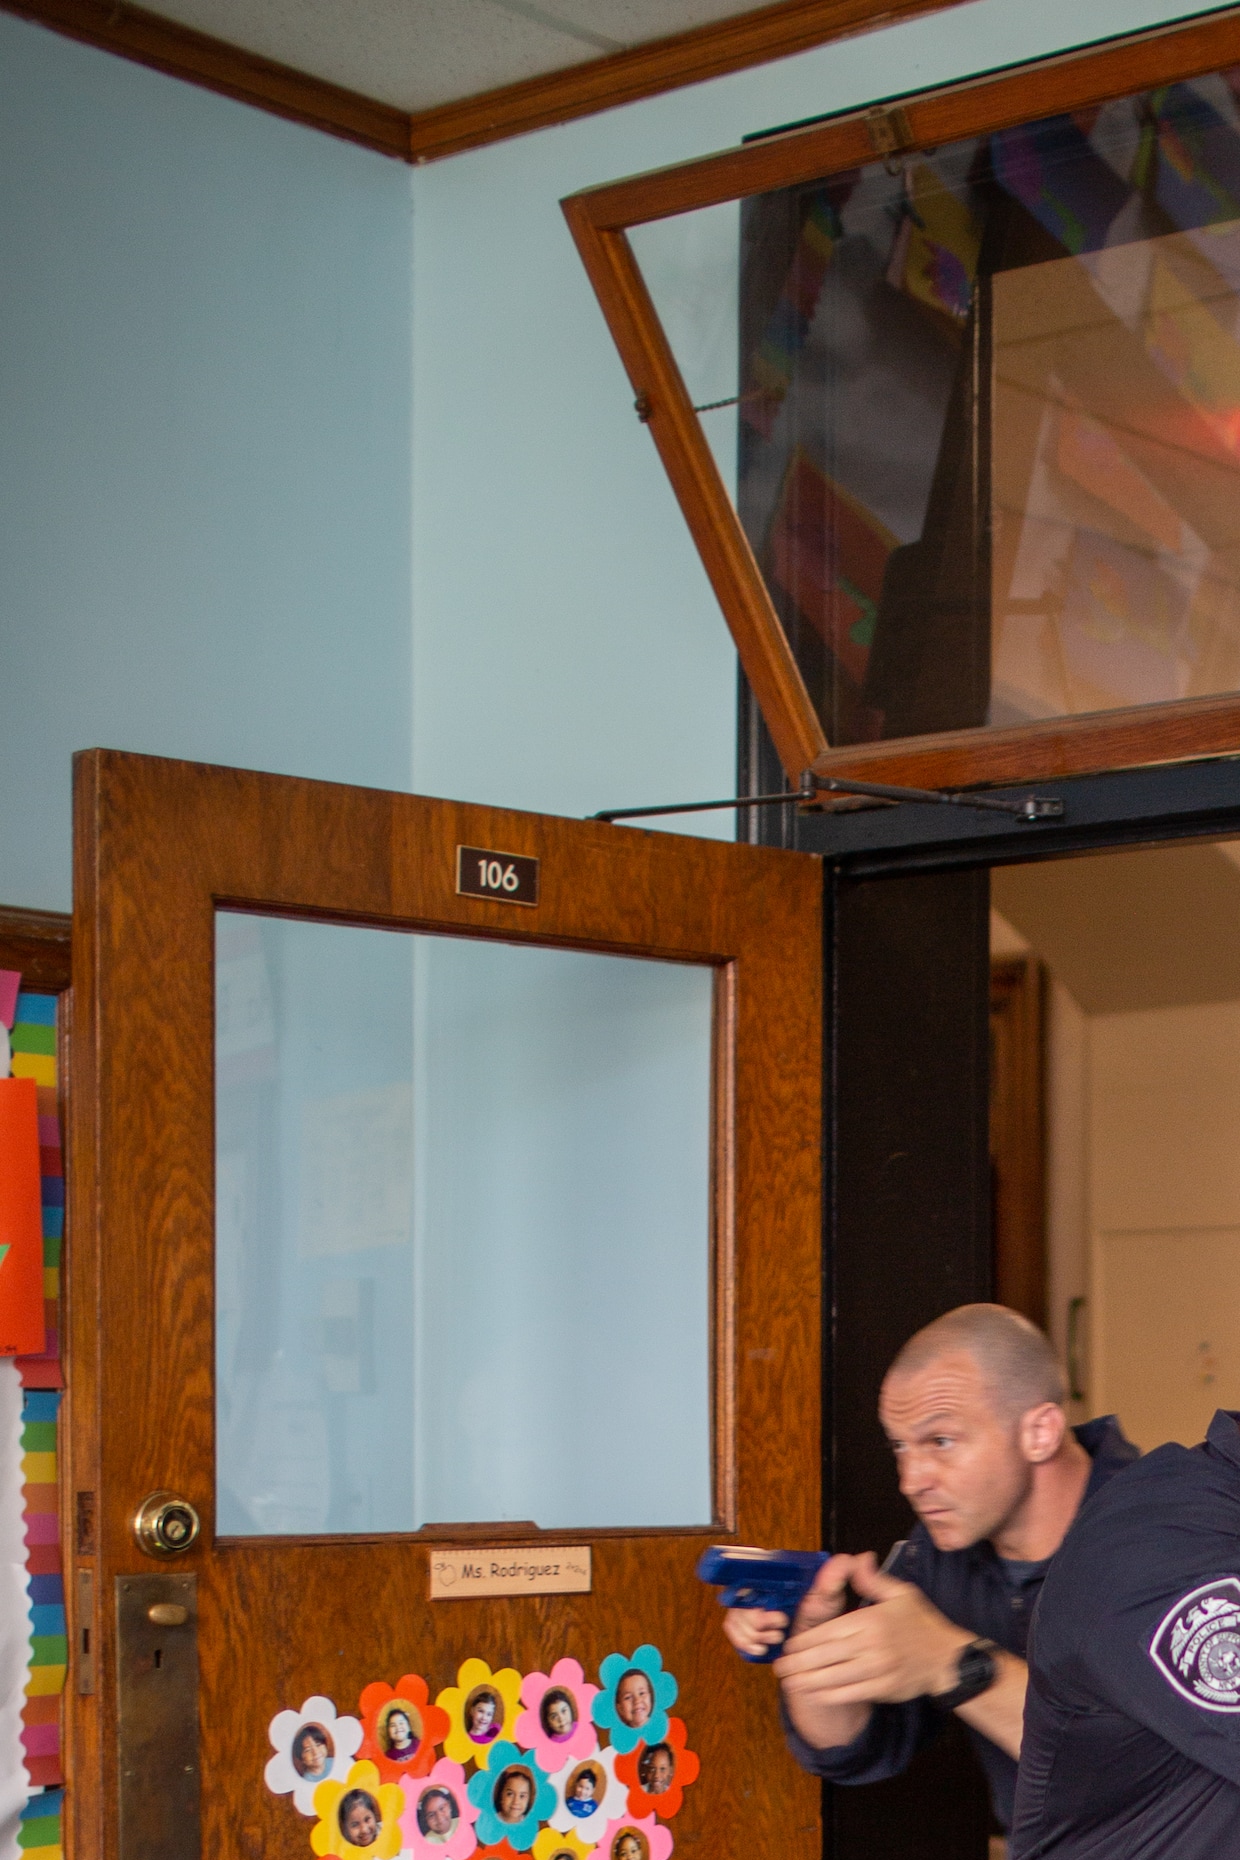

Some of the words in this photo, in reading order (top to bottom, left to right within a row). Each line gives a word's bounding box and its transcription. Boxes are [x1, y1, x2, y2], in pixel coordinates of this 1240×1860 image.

[477, 859, 520, 892] 106
[461, 1563, 486, 1579] Ms.
[490, 1562, 561, 1581] Rodriguez
[1188, 1618, 1224, 1654] POLICE
